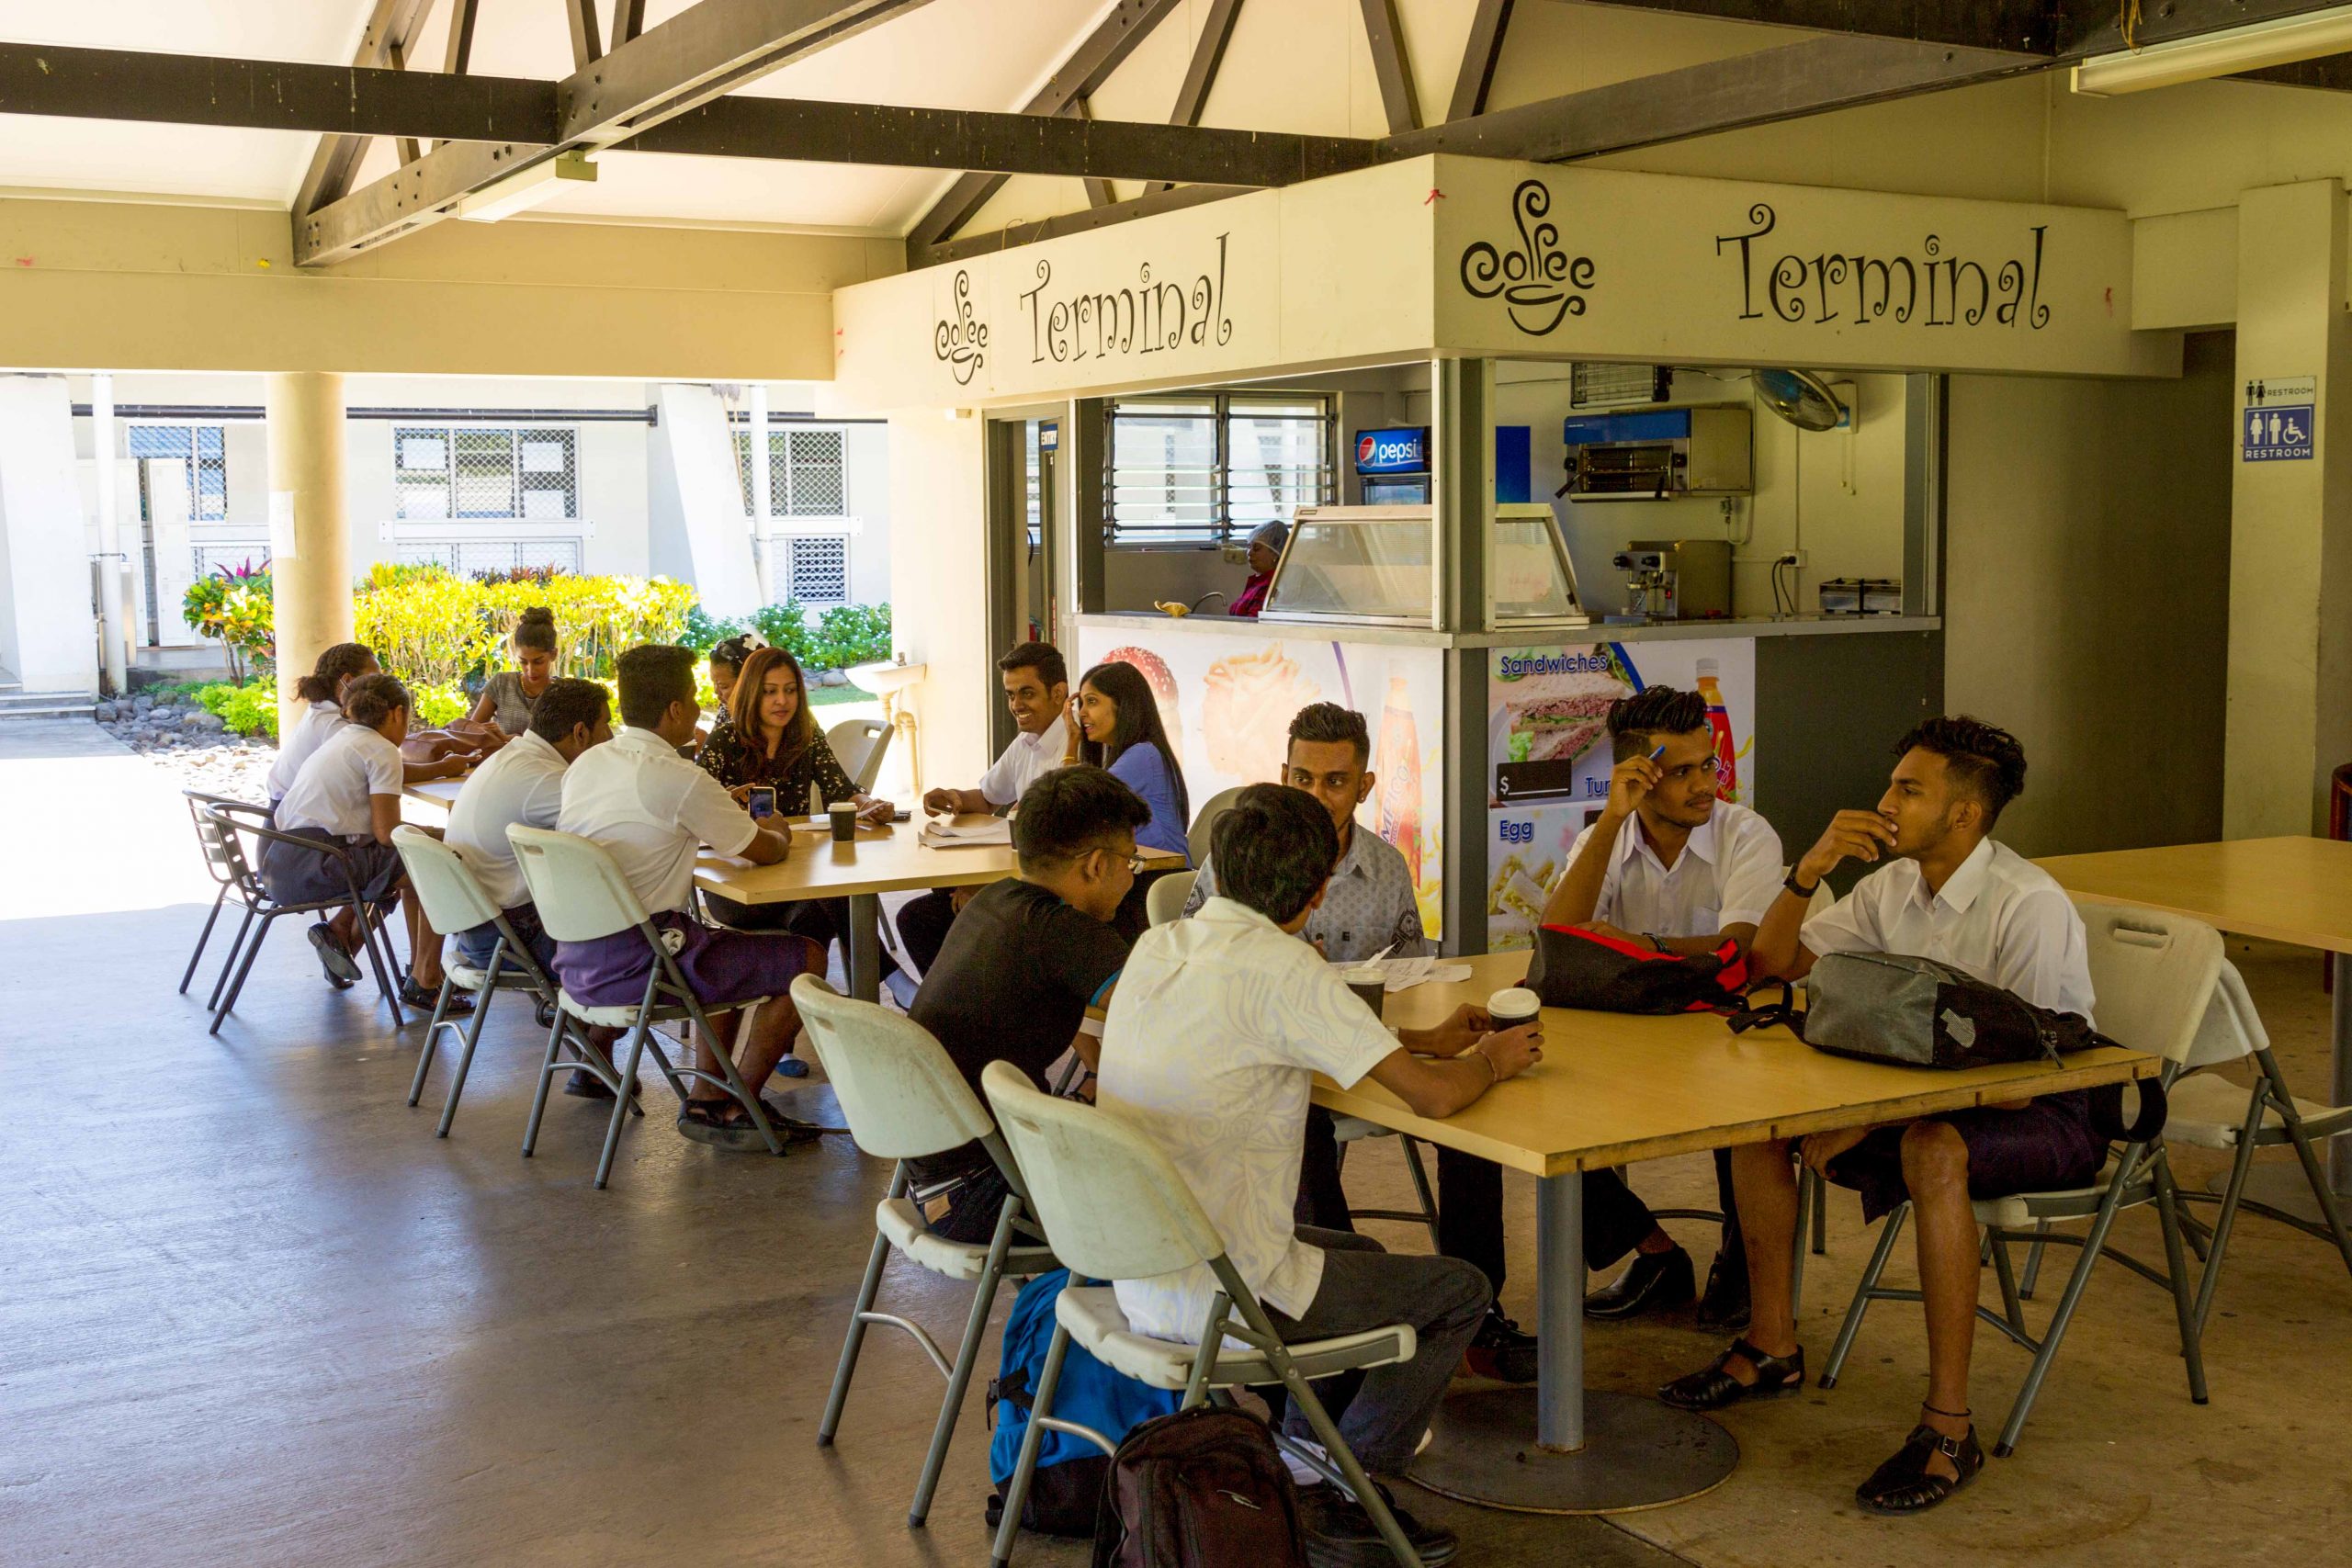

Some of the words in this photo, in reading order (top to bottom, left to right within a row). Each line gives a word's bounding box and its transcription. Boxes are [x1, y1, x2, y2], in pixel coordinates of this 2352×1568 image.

[1716, 203, 2050, 330] Terminal
[1020, 231, 1232, 364] Terminal
[2267, 389, 2313, 397] RESTROOM
[1379, 438, 1418, 463] pepsi
[2245, 448, 2311, 458] RESTROOM
[1500, 653, 1608, 675] Sandwiches
[1500, 819, 1534, 841] Egg
